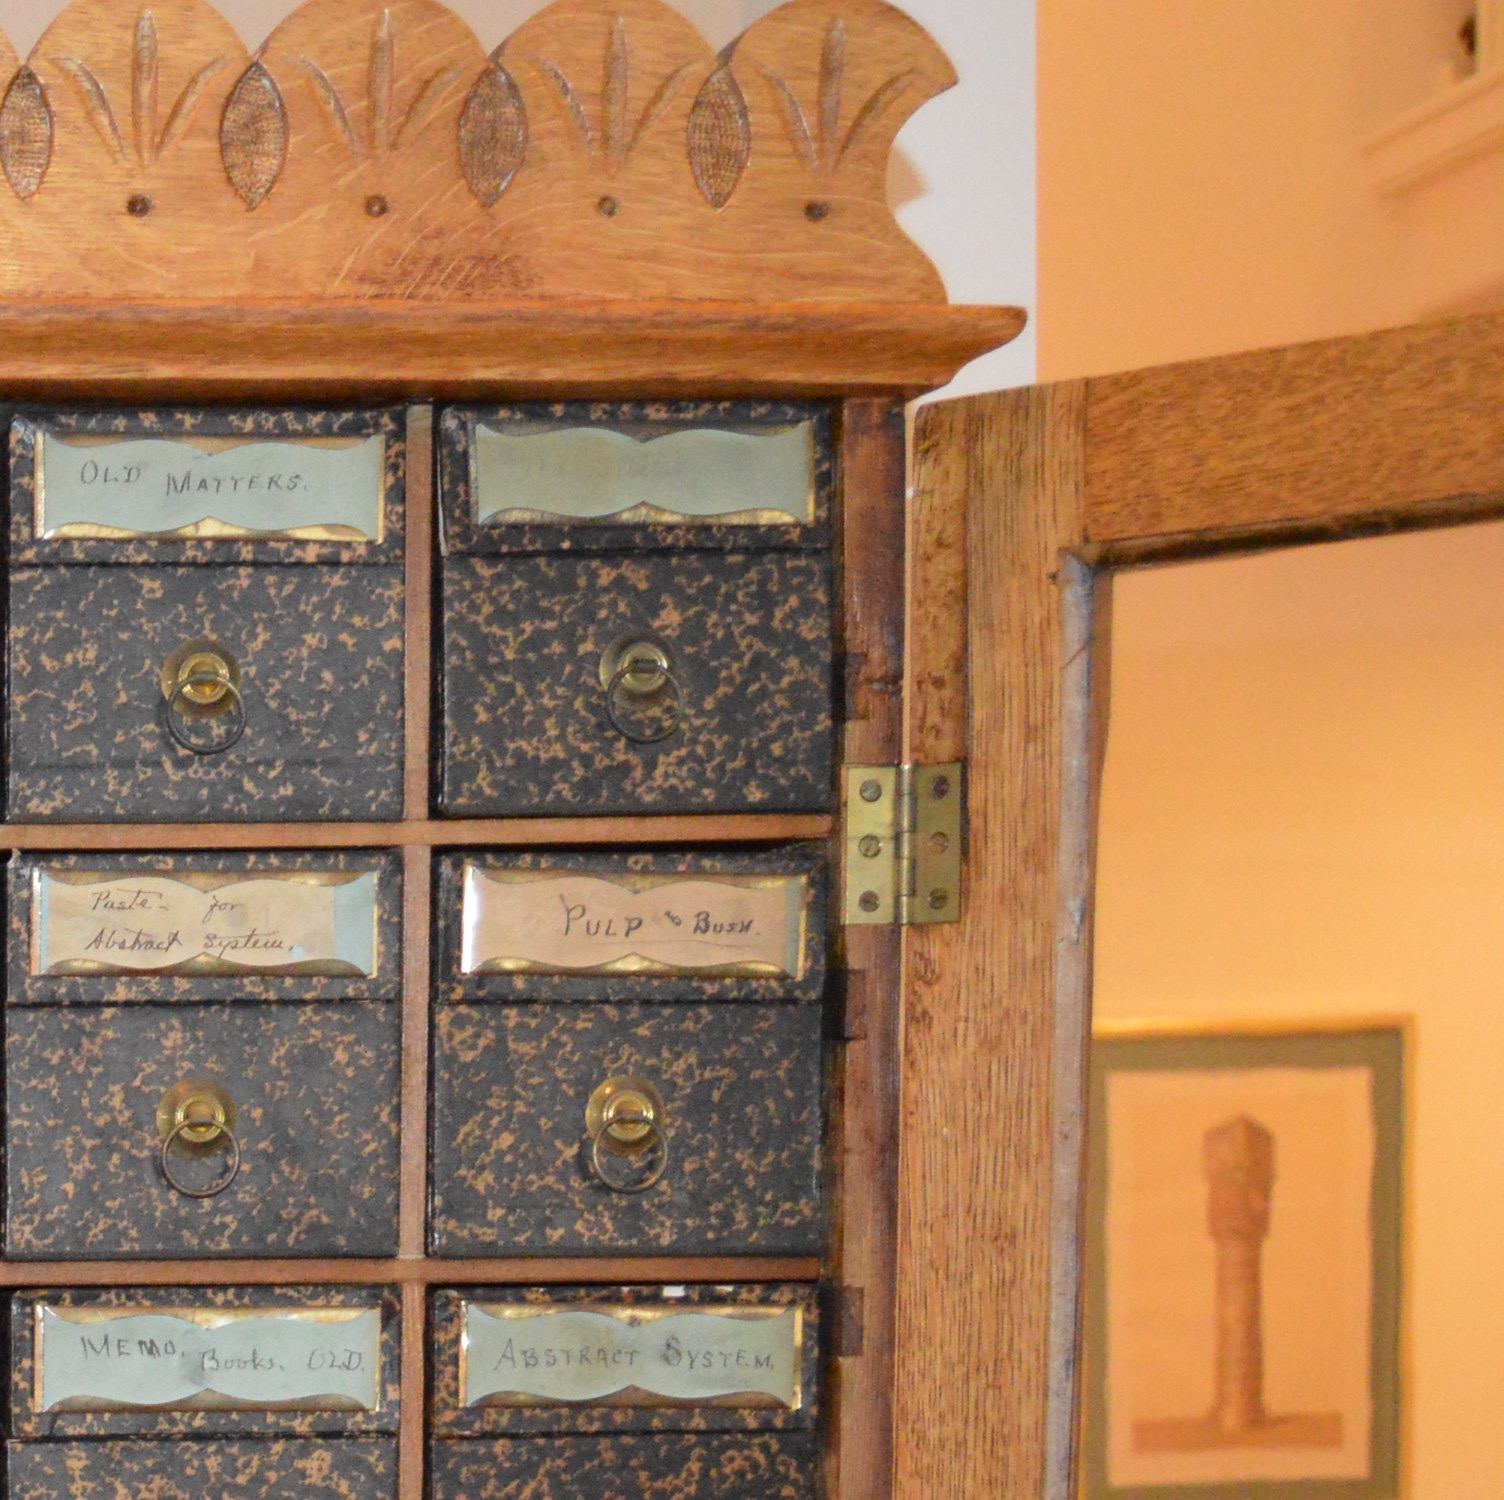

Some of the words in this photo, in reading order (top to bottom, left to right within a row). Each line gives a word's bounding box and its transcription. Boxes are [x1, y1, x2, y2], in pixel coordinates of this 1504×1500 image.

[79, 458, 142, 485] OLD
[165, 468, 309, 496] MATTERS.
[200, 894, 245, 924] for
[559, 892, 644, 939] PULP
[84, 927, 183, 952] Abstract
[493, 1336, 641, 1372] ABSTRACT
